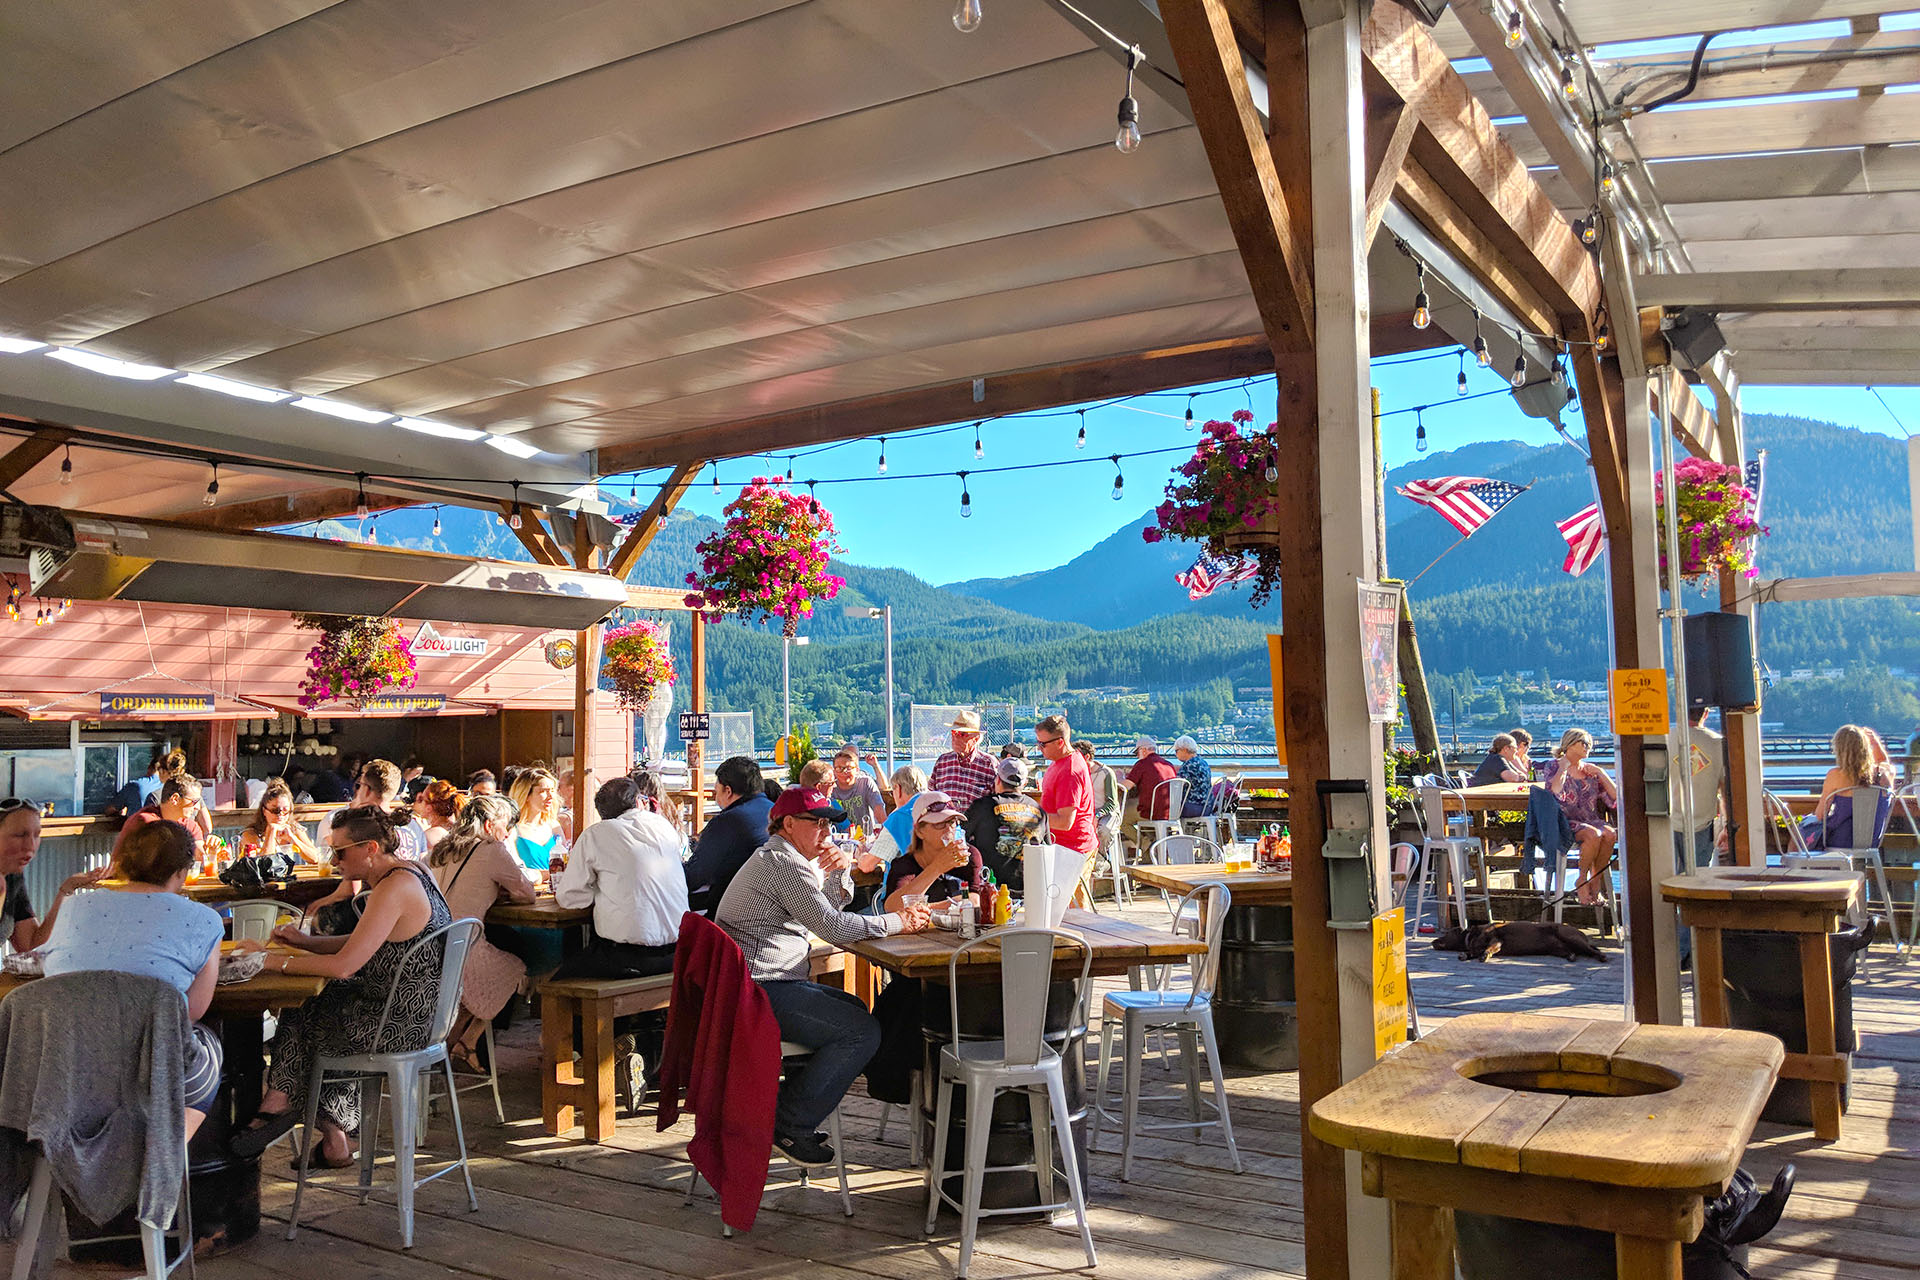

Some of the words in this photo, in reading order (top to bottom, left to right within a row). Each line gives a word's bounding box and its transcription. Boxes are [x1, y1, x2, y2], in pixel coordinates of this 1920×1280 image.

[1384, 594, 1396, 609] ON
[415, 632, 452, 651] Coors
[453, 640, 486, 653] LIGHT
[111, 697, 166, 711] ORDER
[168, 697, 208, 711] HERE
[395, 698, 411, 710] UP
[412, 698, 441, 710] HERE
